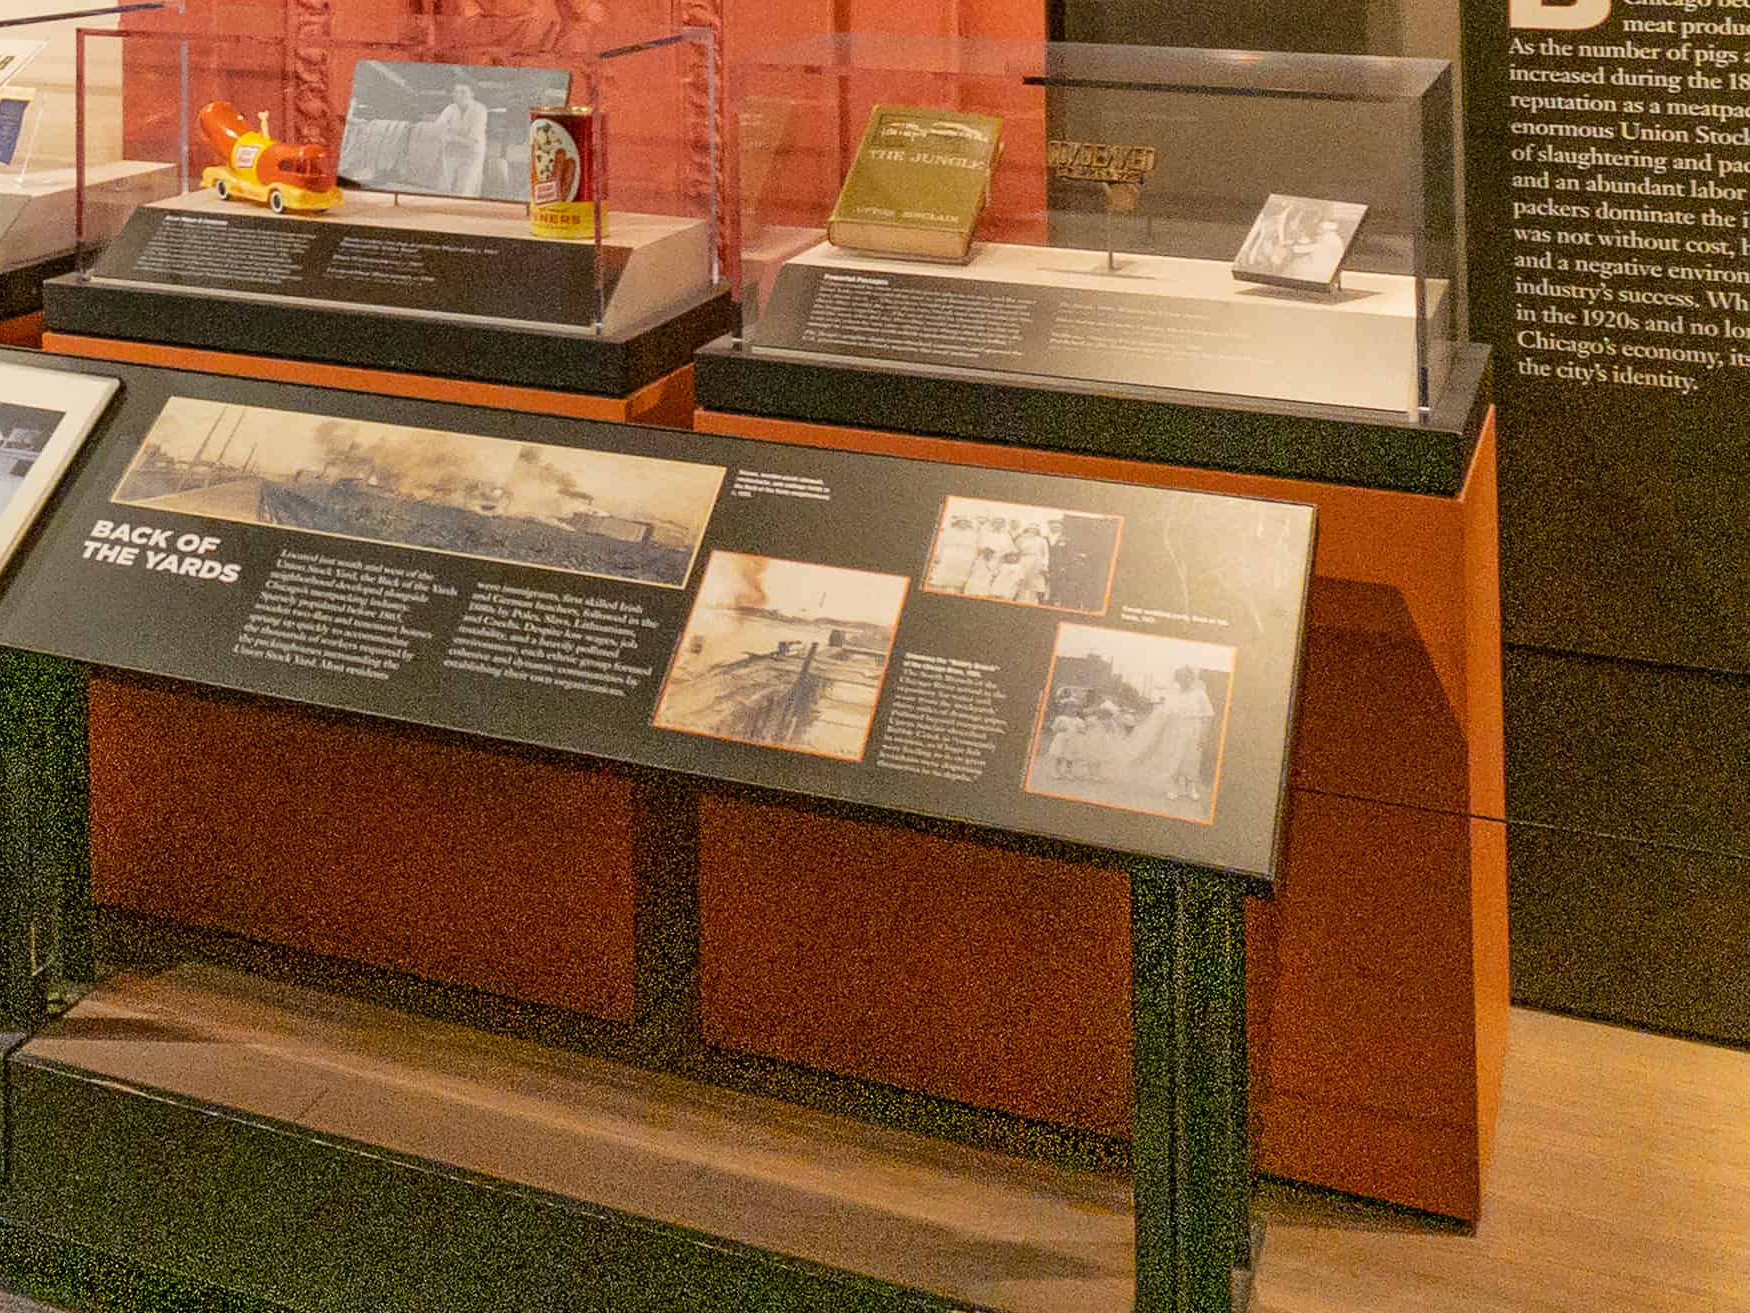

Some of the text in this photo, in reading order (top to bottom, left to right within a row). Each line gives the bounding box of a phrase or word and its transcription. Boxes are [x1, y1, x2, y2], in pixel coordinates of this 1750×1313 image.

[1623, 18, 1676, 32] meat
[1509, 35, 1535, 54] As
[1540, 37, 1574, 55] the
[1579, 40, 1662, 59] number
[1666, 42, 1689, 60] of
[1695, 43, 1739, 67] pigs
[1510, 63, 1605, 84] increased
[1611, 67, 1683, 92] during
[1688, 70, 1723, 88] the
[1511, 92, 1618, 112] reputation
[1623, 99, 1645, 112] as
[1649, 101, 1661, 113] a
[1511, 121, 1615, 139] enormous
[1622, 122, 1690, 143] Union
[868, 149, 988, 170] THE JUNGLE
[1511, 142, 1533, 160] of
[1538, 144, 1668, 173] slaughtering
[1673, 152, 1713, 171] and
[1512, 170, 1748, 200] and an abundant labor
[1513, 197, 1591, 218] packers
[1595, 201, 1696, 225] dominate
[1701, 208, 1737, 227] the
[1514, 228, 1735, 256] was not without cost,
[1515, 250, 1553, 269] and
[1558, 258, 1570, 270] a
[1575, 257, 1663, 278] negative
[1516, 275, 1614, 304] industry's
[1618, 289, 1700, 308] success.
[1516, 301, 1537, 320] in
[1542, 304, 1577, 324] the
[1583, 308, 1640, 329] 1920s
[1645, 314, 1685, 333] and
[1690, 322, 1720, 336] no
[1517, 330, 1617, 358] Chicago's
[1622, 344, 1724, 368] economy,
[1518, 357, 1699, 394] the city's identity.
[90, 520, 221, 554] BACK OF
[82, 541, 242, 583] THE YARDS
